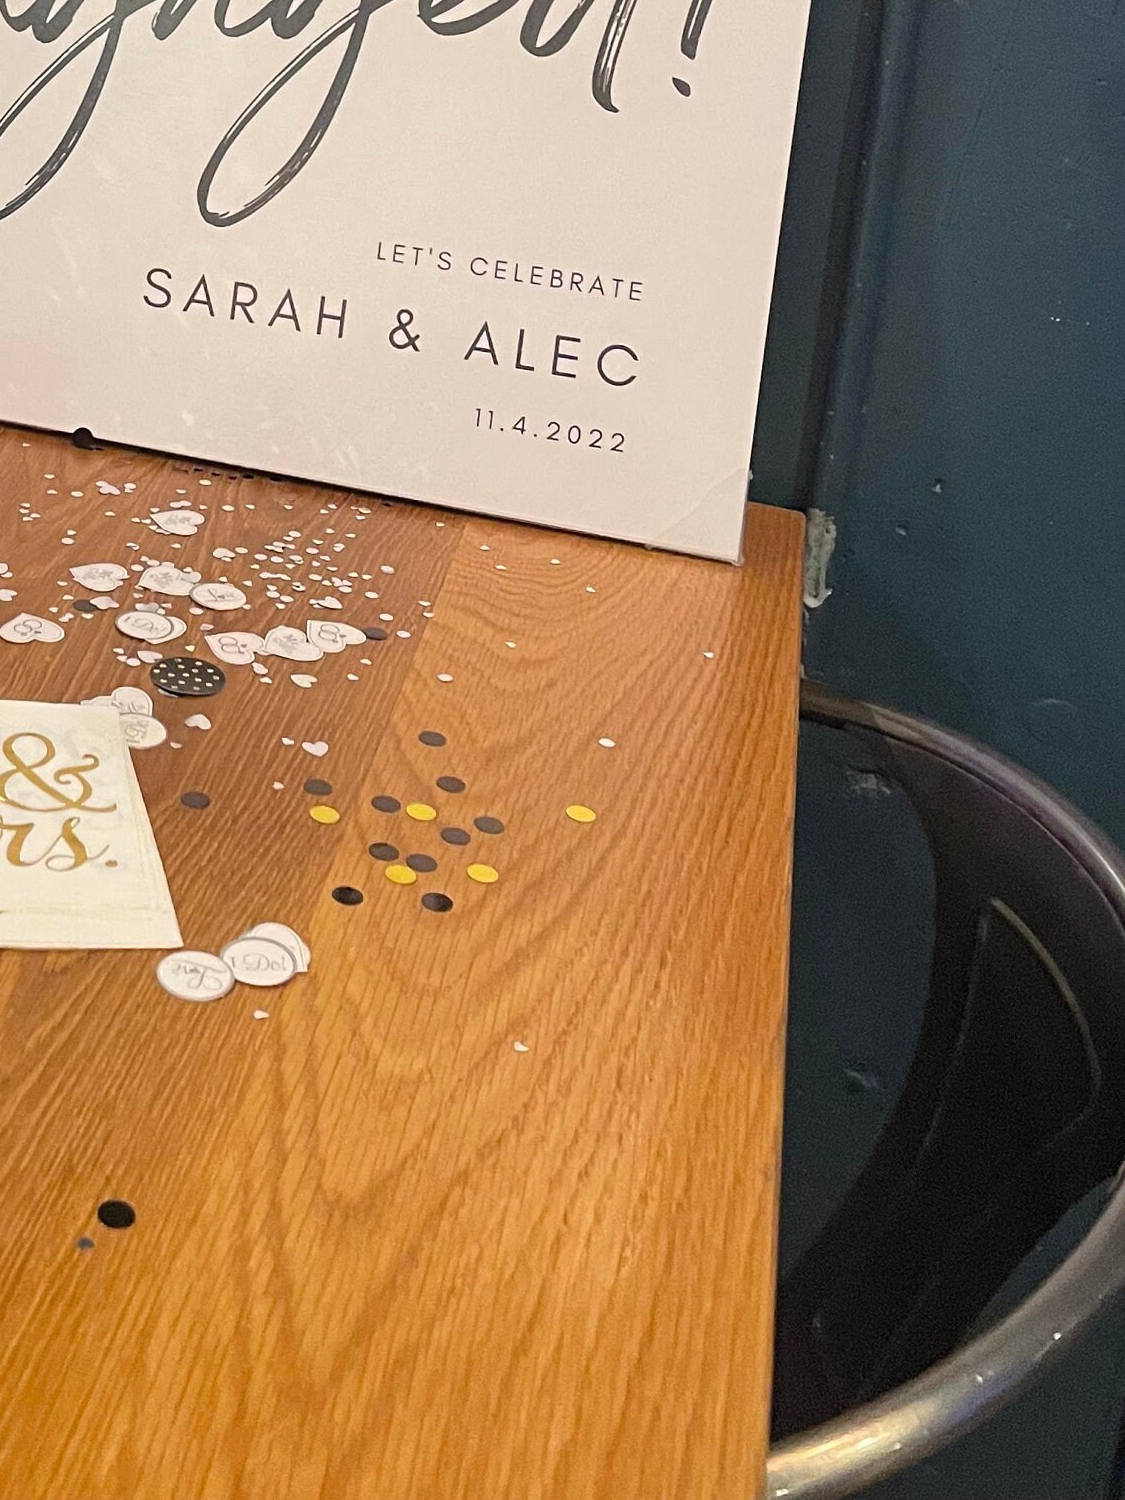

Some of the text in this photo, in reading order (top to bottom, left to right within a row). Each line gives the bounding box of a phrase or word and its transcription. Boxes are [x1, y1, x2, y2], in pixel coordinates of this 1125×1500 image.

[375, 240, 645, 302] LET'S CELEBRATE
[142, 267, 640, 387] SARAH & ALEC
[474, 407, 627, 454] 11.4.2022
